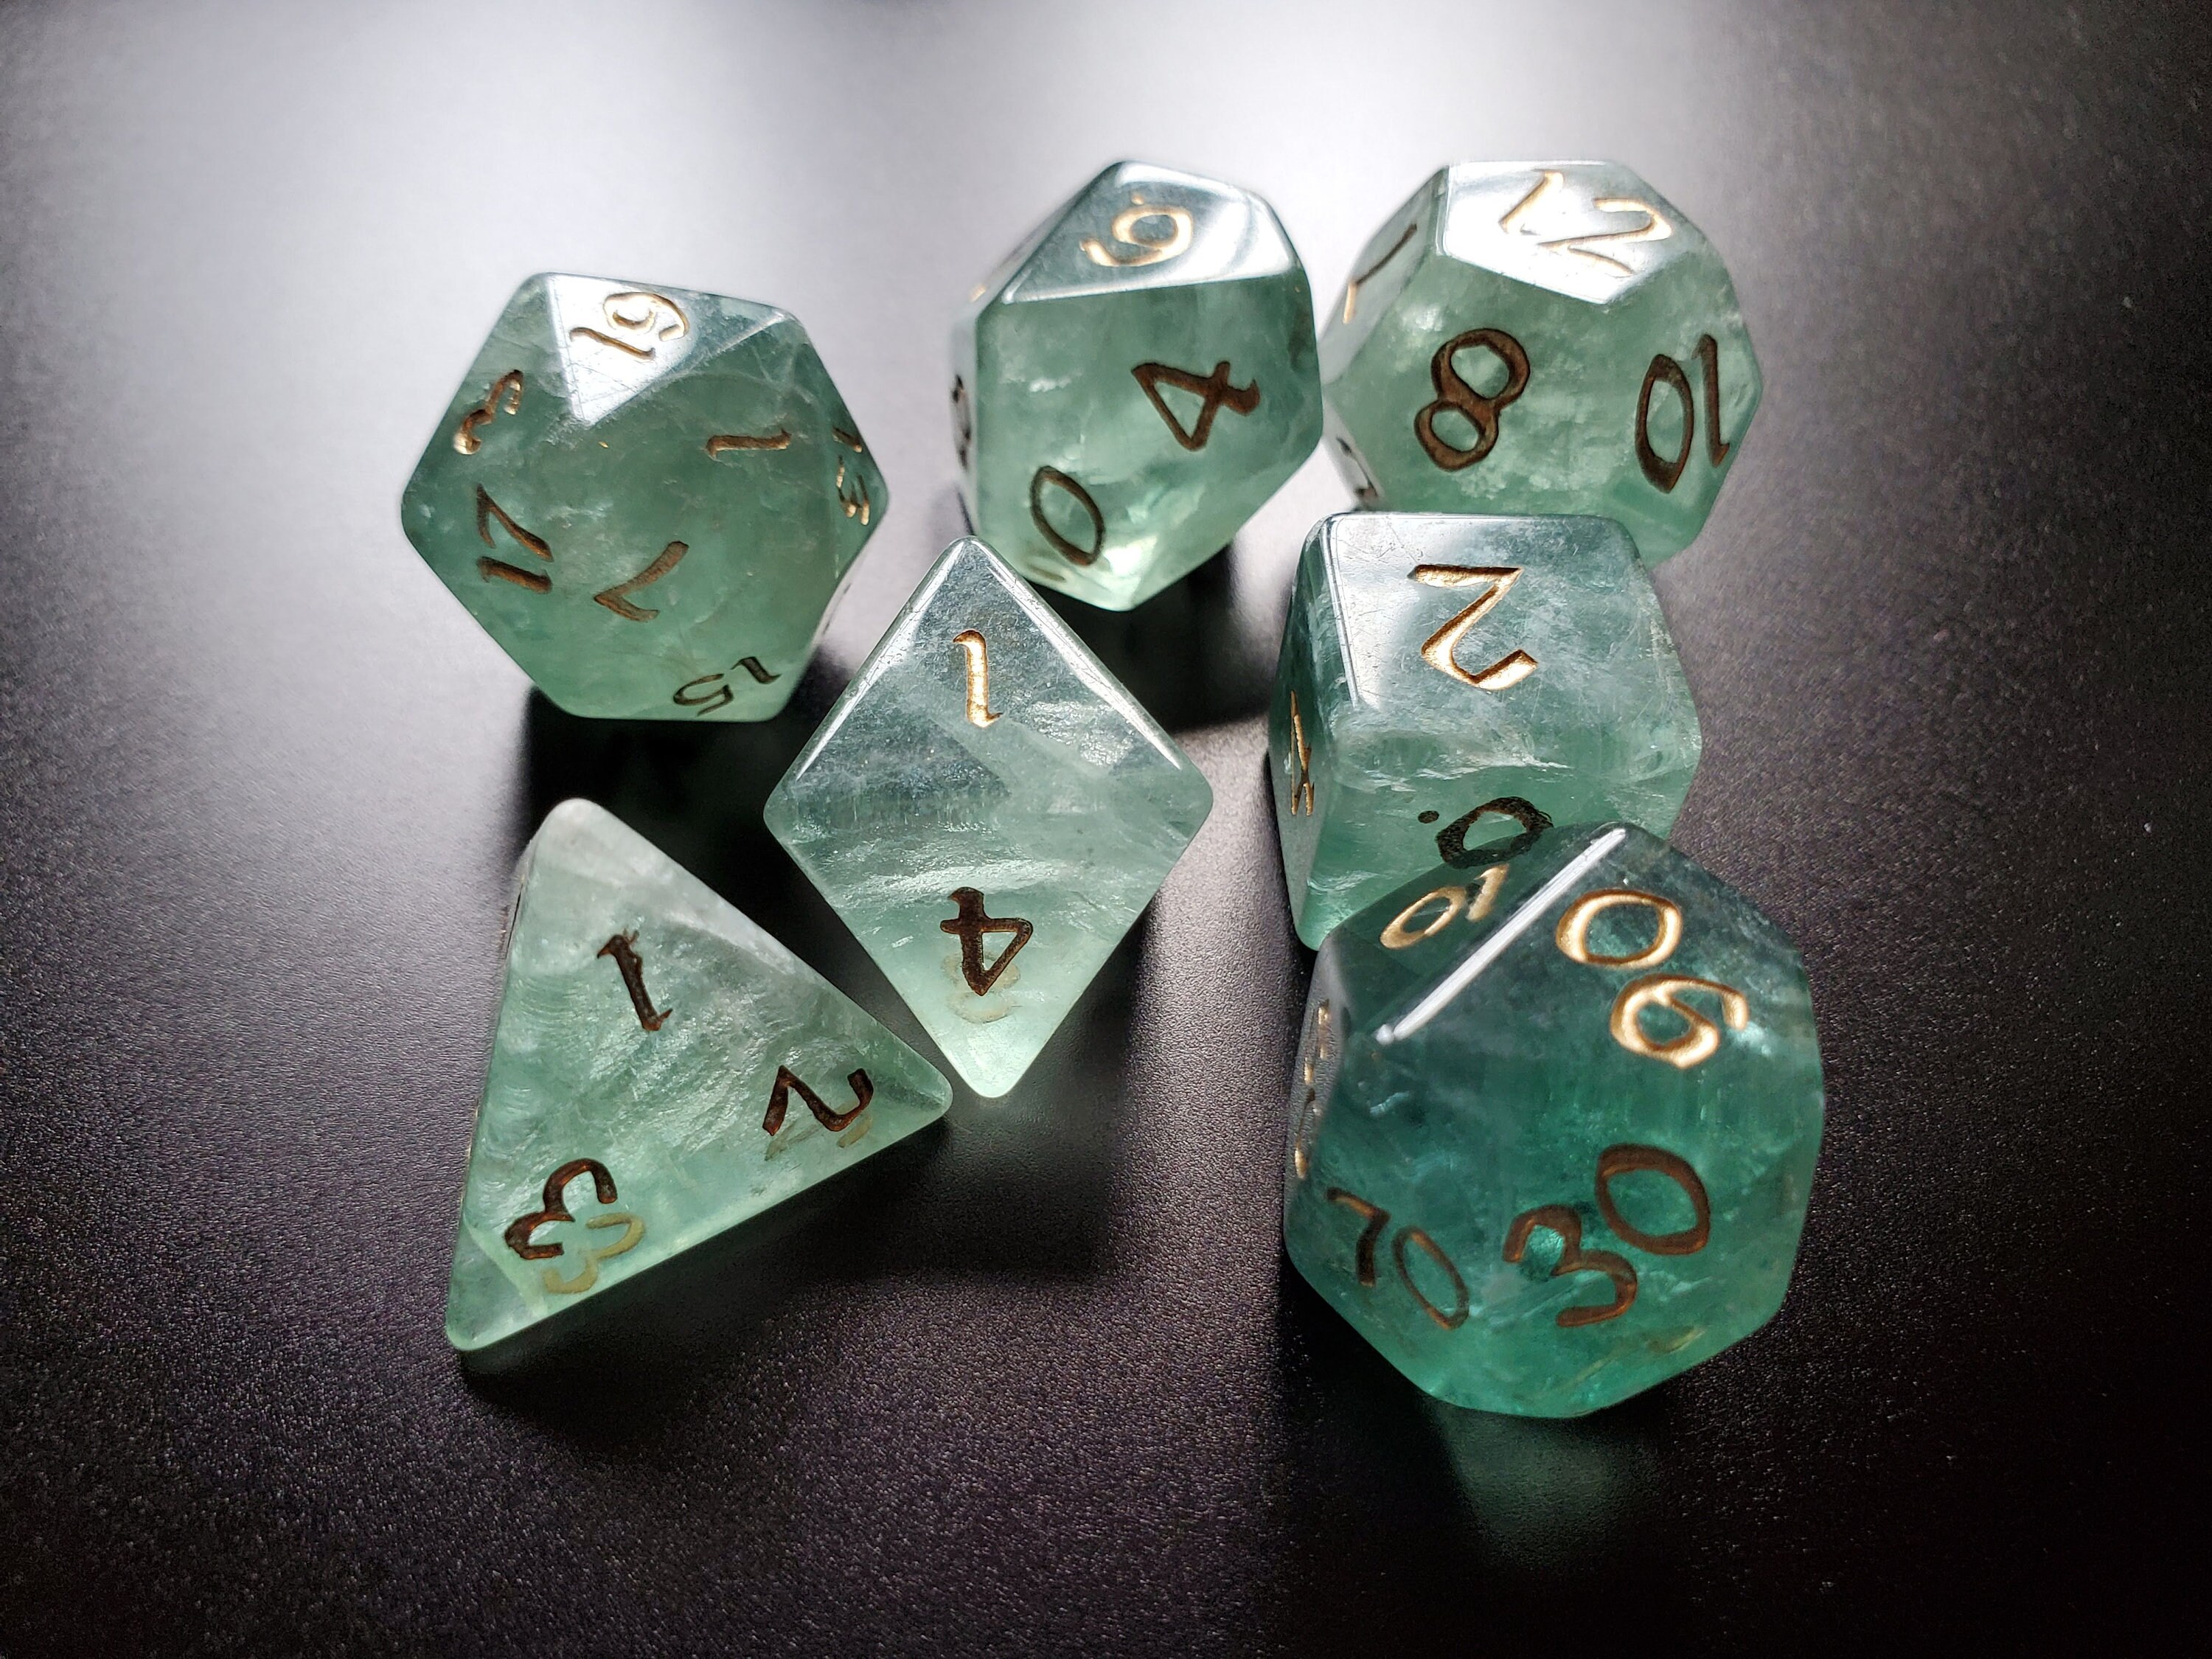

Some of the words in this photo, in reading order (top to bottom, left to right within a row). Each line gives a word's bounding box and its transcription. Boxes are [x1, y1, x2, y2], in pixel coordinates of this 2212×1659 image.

[1131, 361, 1261, 452] 4
[1414, 328, 1531, 473] 8
[1635, 333, 1730, 495] 10
[1030, 465, 1105, 566] 0
[594, 540, 690, 624] 7
[1409, 563, 1539, 691] 2
[673, 656, 782, 717] 15
[953, 630, 1004, 728] 1
[597, 929, 673, 1032] 1
[940, 887, 1032, 997] 4
[762, 1065, 874, 1138] 2
[504, 1158, 618, 1259] 3
[1327, 1186, 1470, 1330] 70
[1502, 1144, 1711, 1328] 30
